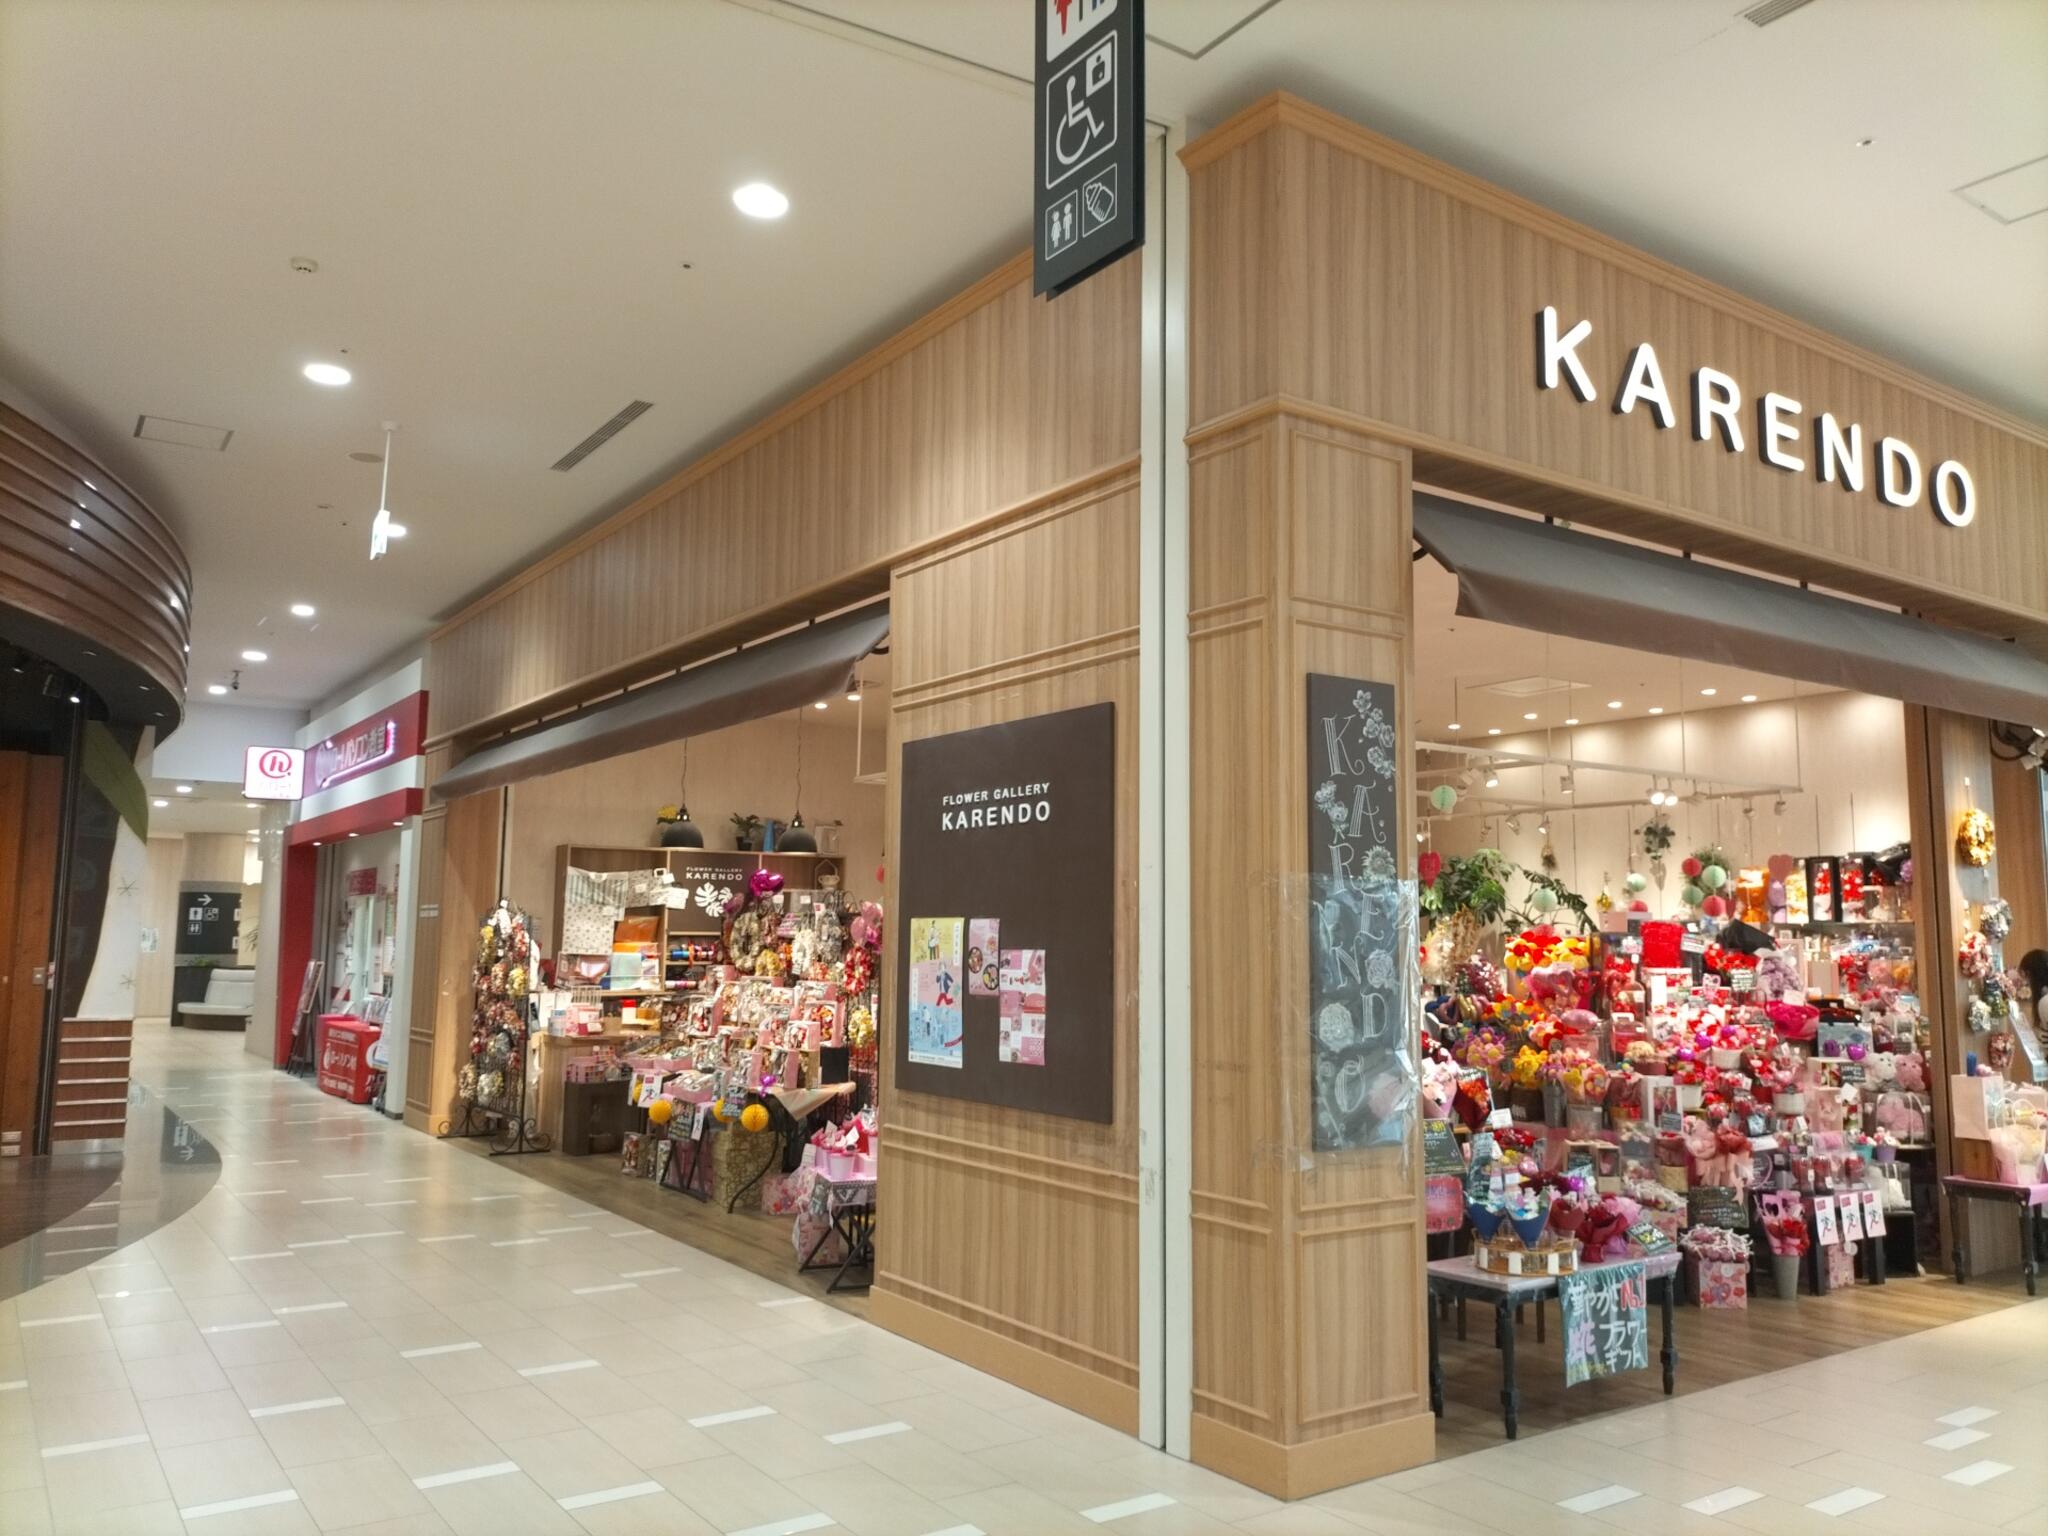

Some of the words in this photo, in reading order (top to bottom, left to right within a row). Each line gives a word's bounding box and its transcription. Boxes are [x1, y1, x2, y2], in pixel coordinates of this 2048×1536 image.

[1538, 306, 1976, 527] KARENDO
[942, 791, 989, 806] FLOWER
[993, 782, 1050, 800] GALLERY
[942, 801, 1051, 831] KARENDO
[685, 872, 743, 881] KARENDO
